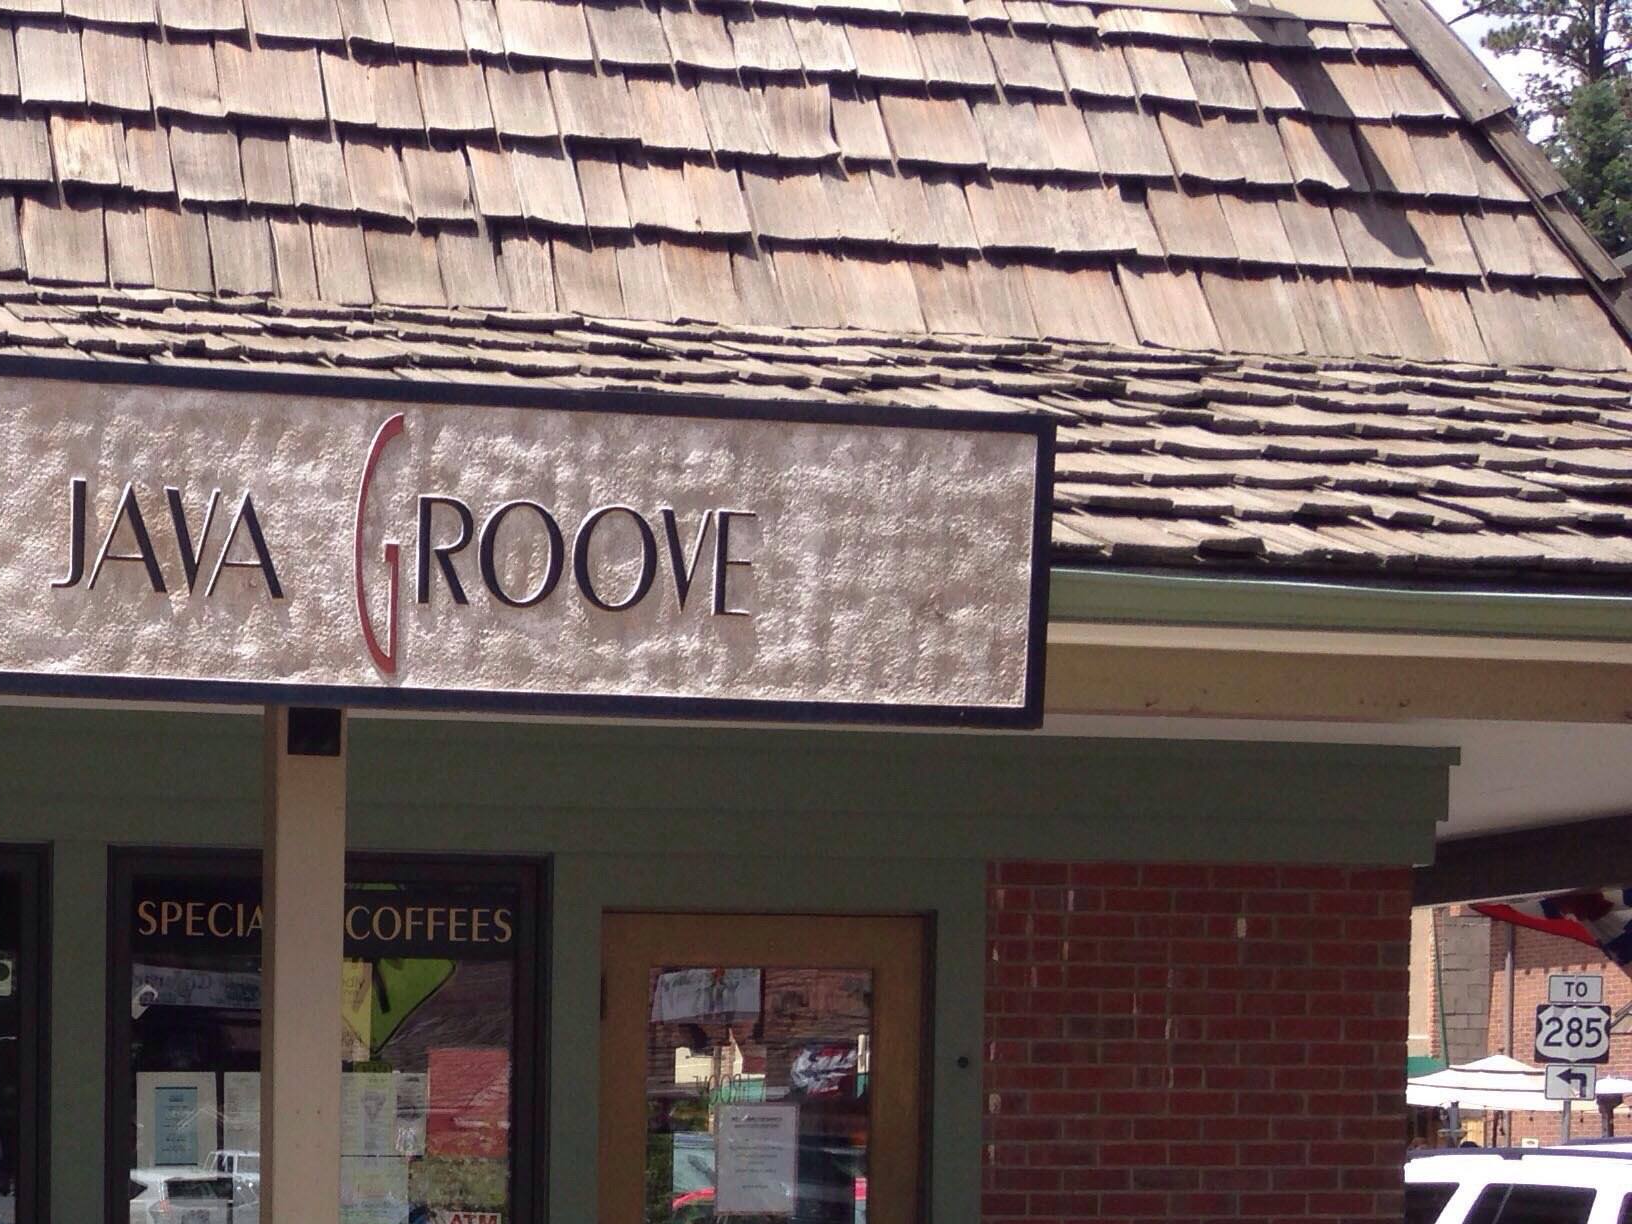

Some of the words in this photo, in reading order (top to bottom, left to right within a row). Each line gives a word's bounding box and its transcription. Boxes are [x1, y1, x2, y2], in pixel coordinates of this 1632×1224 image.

[50, 477, 285, 600] JAVA
[355, 412, 758, 678] GROOVE
[137, 900, 264, 938] SPECIA
[344, 905, 514, 943] COFFEES
[1564, 982, 1588, 998] TO
[1544, 1016, 1602, 1048] 285
